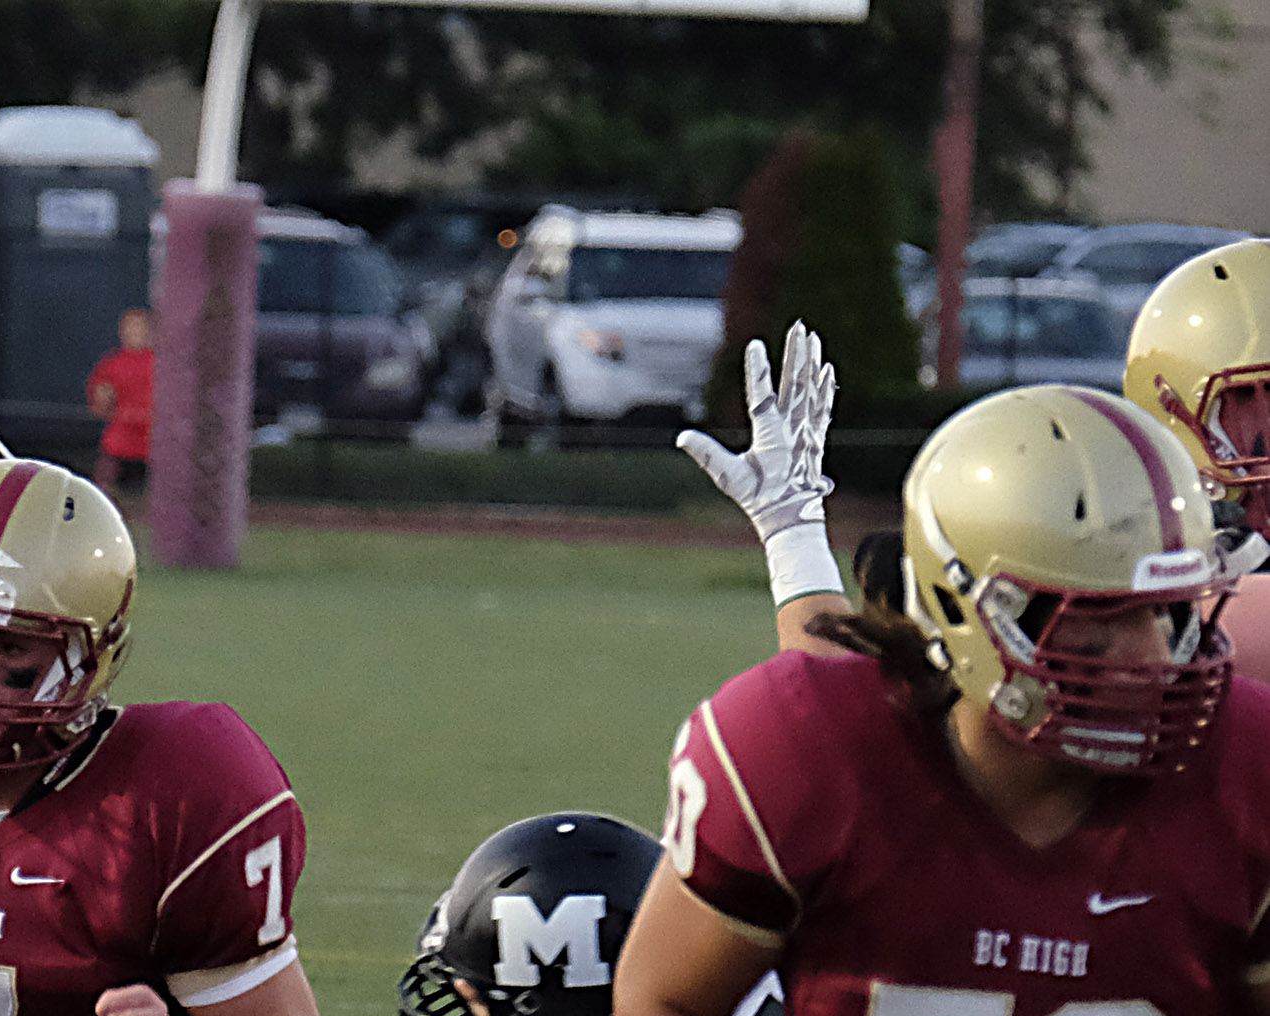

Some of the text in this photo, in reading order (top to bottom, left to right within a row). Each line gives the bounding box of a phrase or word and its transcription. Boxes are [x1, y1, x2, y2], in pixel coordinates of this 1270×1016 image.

[244, 834, 286, 947] 7
[491, 894, 611, 988] M
[974, 929, 1089, 977] BC HIGH
